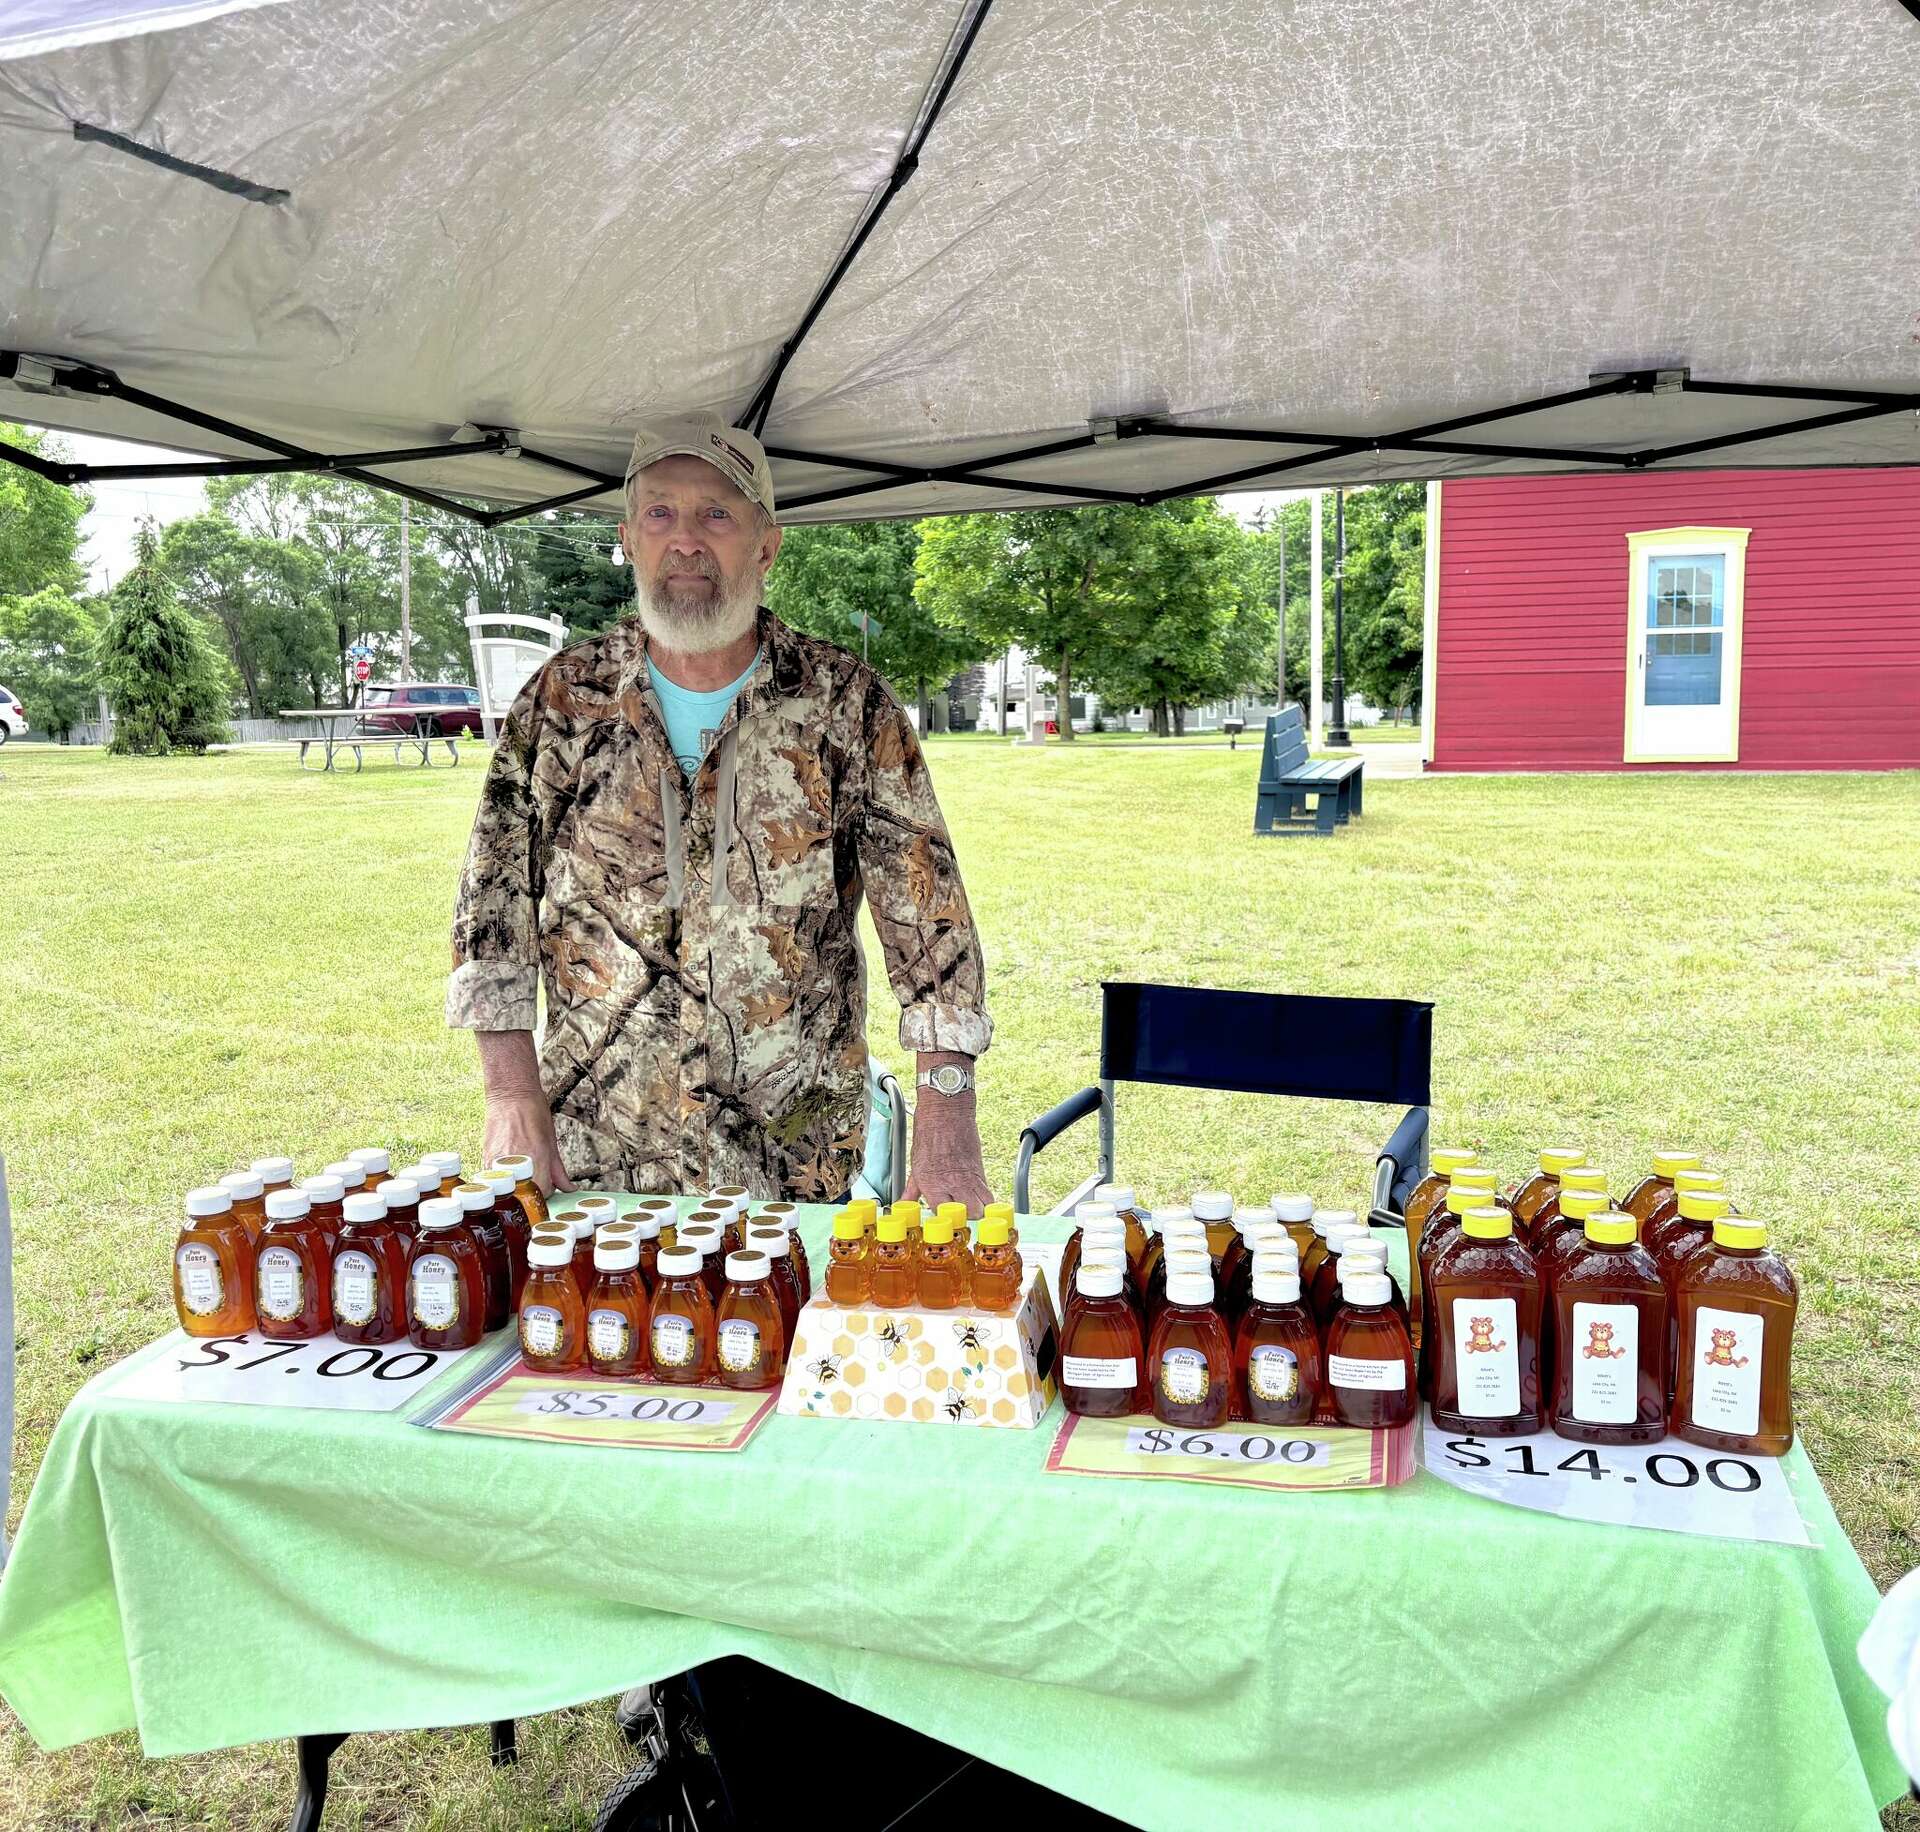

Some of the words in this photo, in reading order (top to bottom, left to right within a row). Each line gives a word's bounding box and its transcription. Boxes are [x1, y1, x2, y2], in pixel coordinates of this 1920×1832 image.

[357, 666, 369, 675] STOP
[267, 1258, 290, 1267] Honey
[344, 1262, 366, 1272] Honey
[423, 1266, 446, 1275] Honey
[178, 1334, 439, 1381] $7.00
[537, 1391, 705, 1421] $5.00
[1138, 1429, 1317, 1463] $6.00
[1444, 1436, 1762, 1492] $14.00
